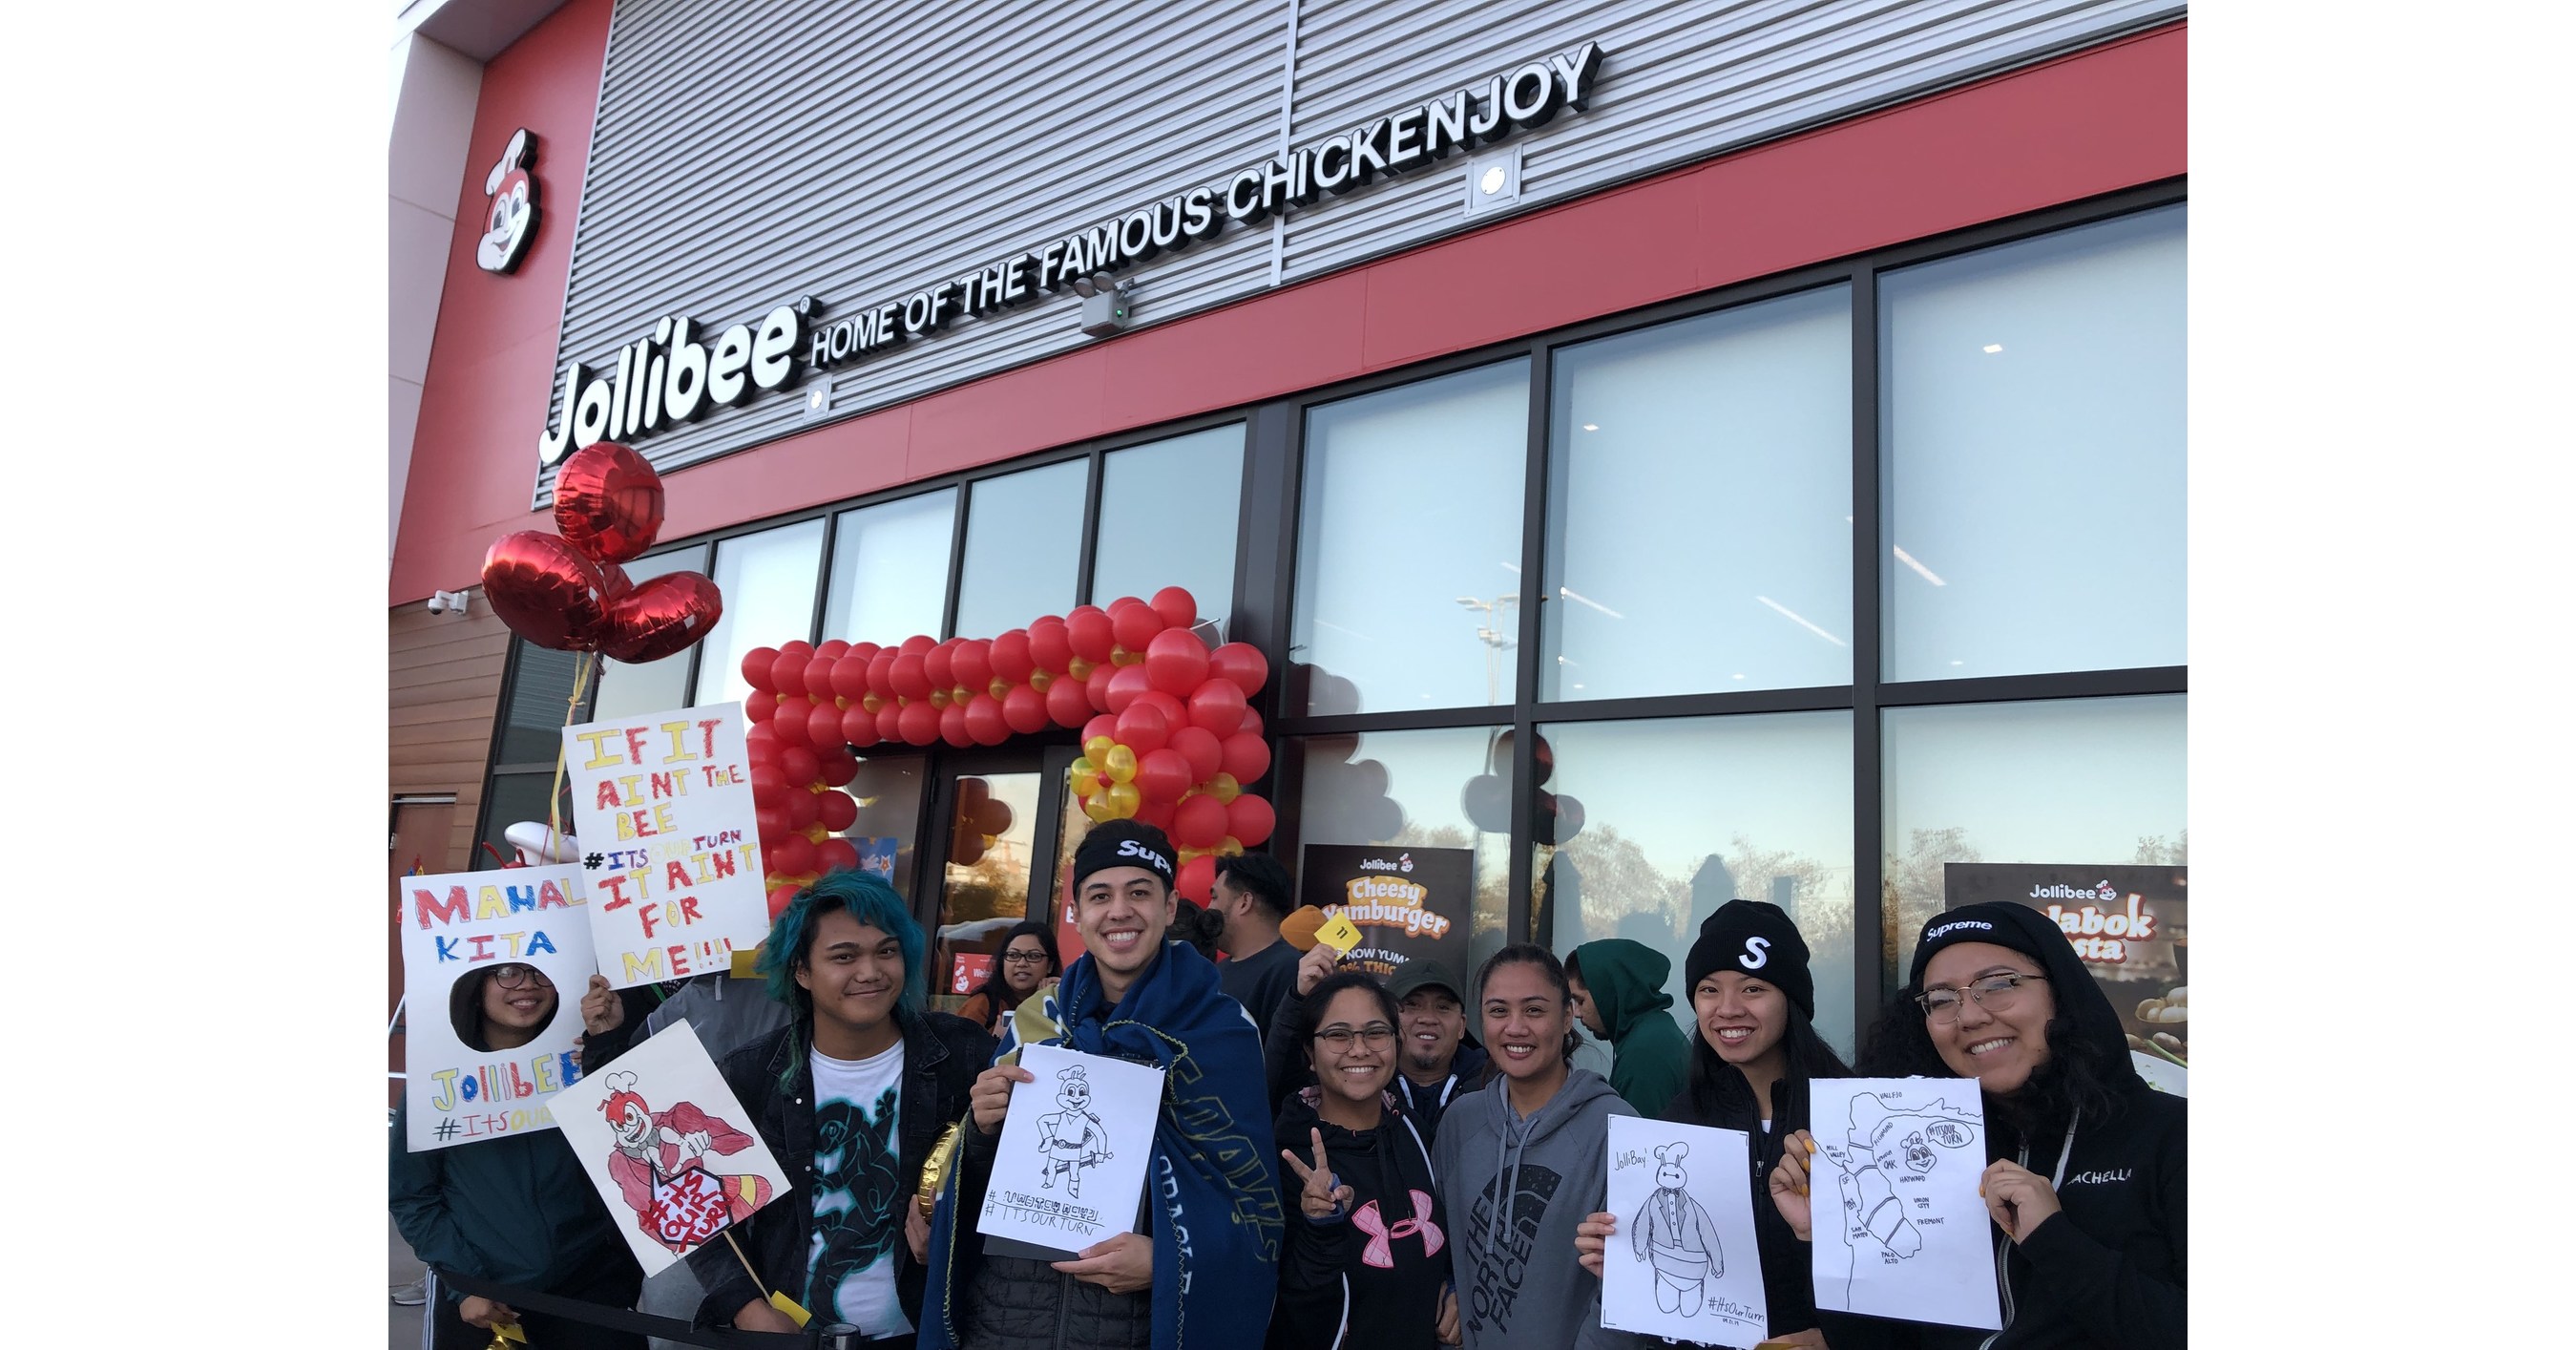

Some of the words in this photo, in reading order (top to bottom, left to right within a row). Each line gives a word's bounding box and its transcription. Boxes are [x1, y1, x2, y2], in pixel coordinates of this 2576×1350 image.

[538, 305, 799, 464] Jollibee
[810, 303, 898, 368] HOME
[905, 282, 954, 333] OF
[959, 253, 1030, 314] THE
[1040, 186, 1213, 288] FAMOUS
[1226, 41, 1597, 220] CHICKENJOY
[576, 727, 649, 770] IF
[660, 718, 722, 764] IT
[597, 768, 690, 811] AINT
[702, 764, 746, 788] THE
[616, 802, 678, 841] BEE
[597, 865, 653, 913] IT
[666, 842, 757, 892] AINT
[1359, 858, 1398, 871] Jollibee
[412, 878, 588, 930] MAHAL
[1351, 878, 1421, 906] Cheesy
[2029, 883, 2096, 900] Jollibee
[639, 896, 702, 939] FOR
[1926, 920, 1993, 942] Supreme
[435, 930, 557, 963] KITA
[1347, 948, 1376, 960] NOW
[1738, 936, 1771, 970] S
[1940, 1133, 1963, 1145] TURN
[1899, 1174, 1926, 1183] HAYWARD
[1489, 1232, 1533, 1336] FACE
